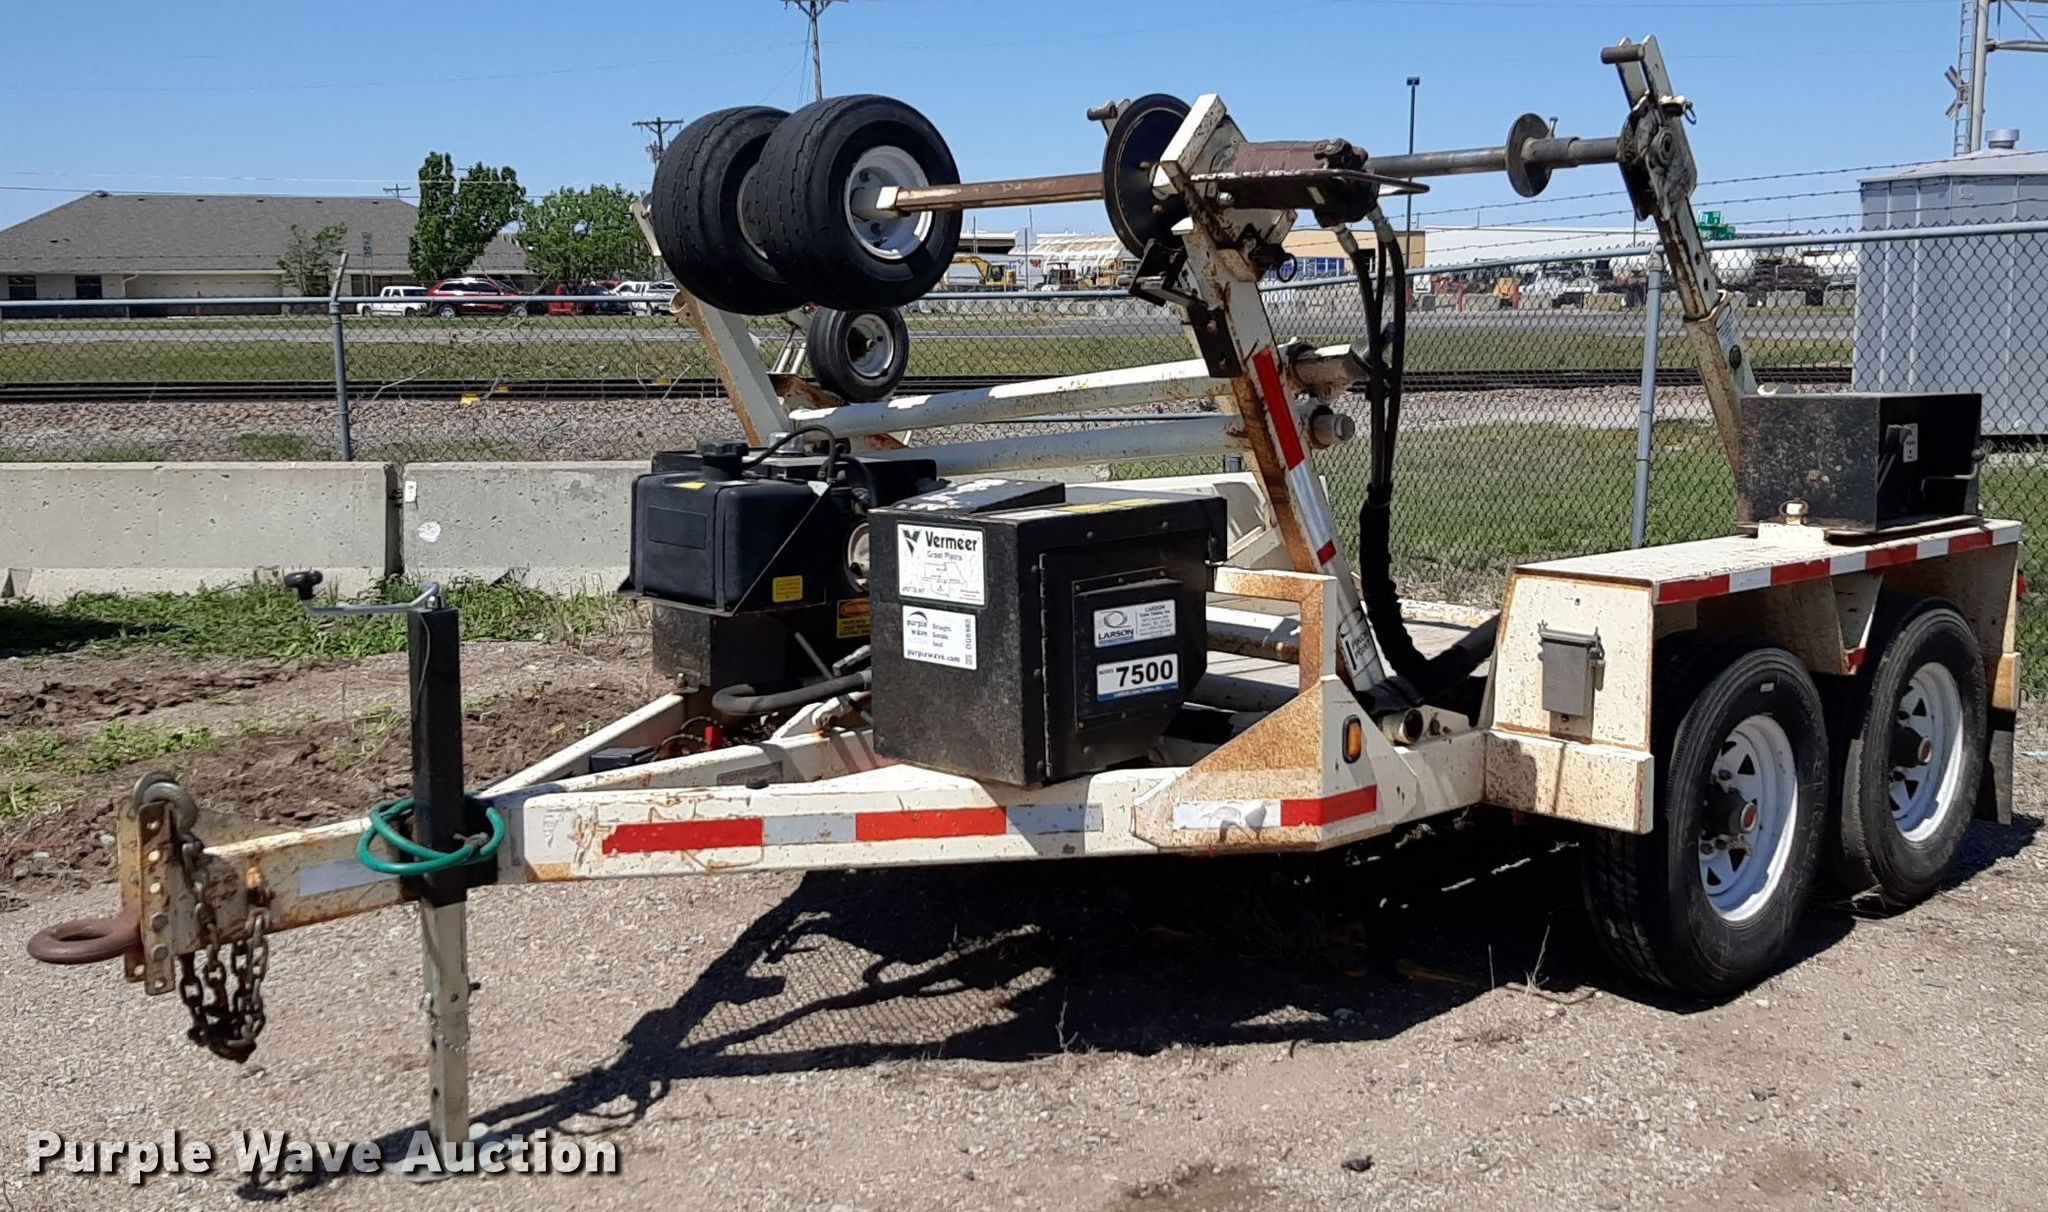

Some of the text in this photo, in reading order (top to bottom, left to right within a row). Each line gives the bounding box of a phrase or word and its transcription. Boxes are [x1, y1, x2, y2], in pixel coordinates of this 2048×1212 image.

[925, 530, 978, 552] Vermeer
[1098, 628, 1134, 640] LARSON
[1115, 659, 1173, 688] 7500
